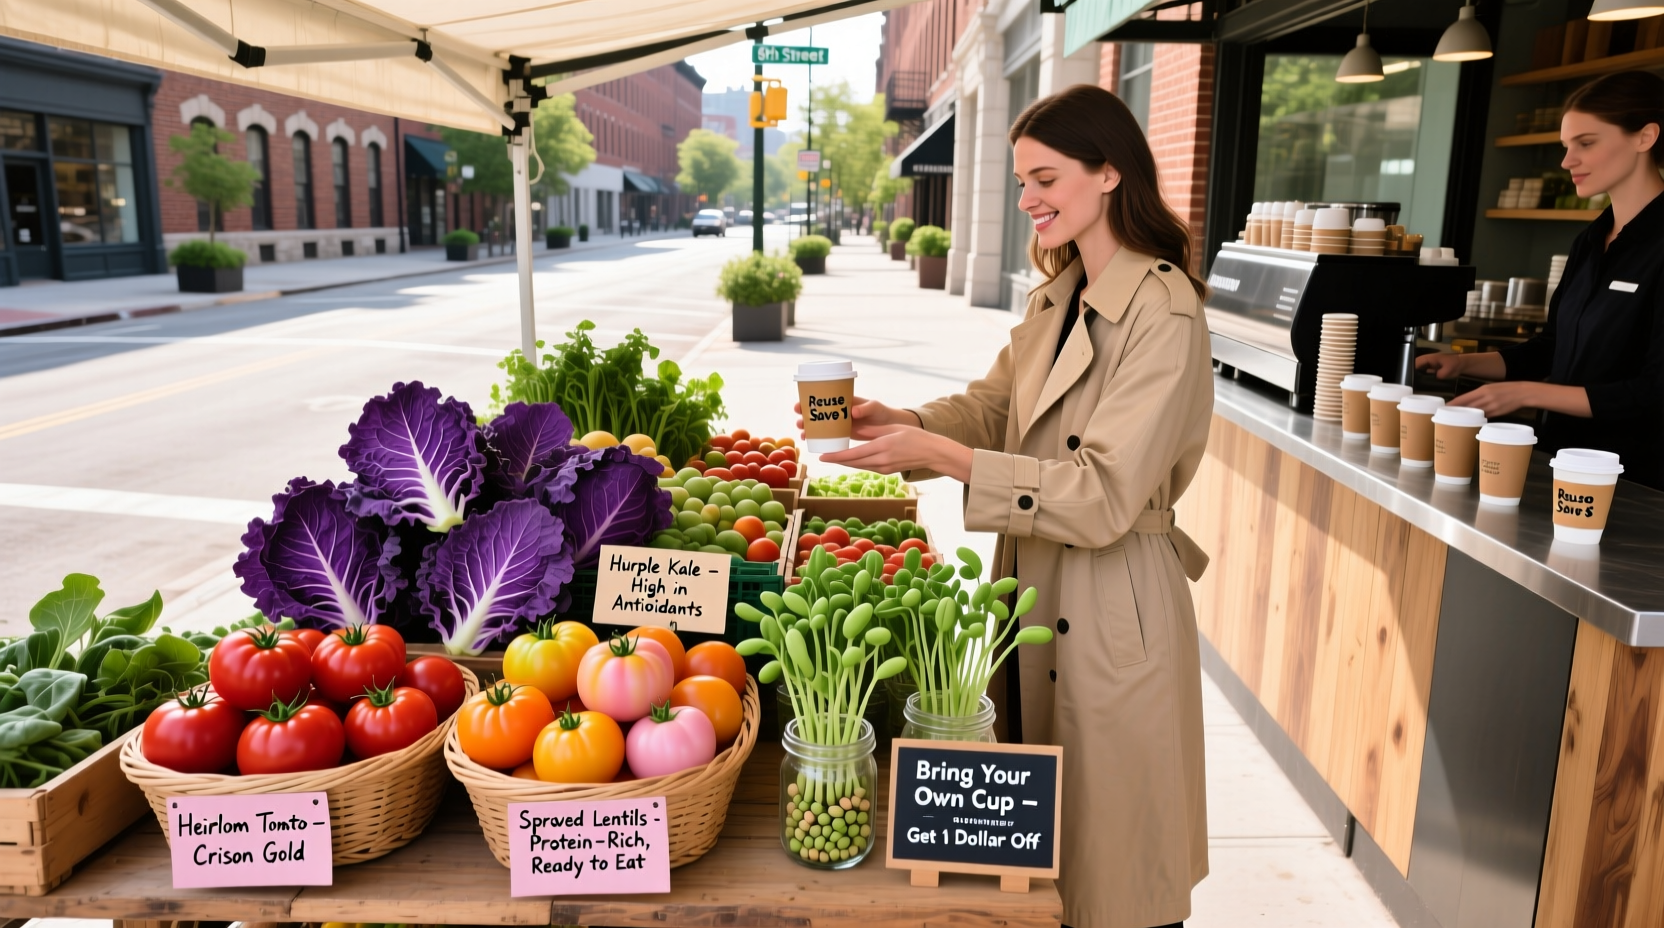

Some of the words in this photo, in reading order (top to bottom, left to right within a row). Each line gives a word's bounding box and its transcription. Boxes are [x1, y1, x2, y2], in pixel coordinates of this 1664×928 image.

[609, 554, 660, 577] Hurple
[668, 557, 701, 577] Kale
[631, 577, 666, 598] High
[673, 582, 687, 595] in
[611, 594, 703, 617] Antioidants
[916, 760, 974, 789] Bring
[981, 764, 1031, 786] Your
[914, 786, 964, 808] Own
[971, 789, 1015, 816] Cup
[178, 812, 249, 837] Heirlom
[255, 811, 308, 833] Tomto
[593, 808, 647, 827] Lentils
[907, 827, 937, 844] Get
[942, 828, 949, 845] 1
[955, 829, 1006, 848] Dollar
[1011, 832, 1042, 850] Off
[193, 843, 253, 866] Crison
[262, 839, 305, 864] Gold
[531, 855, 584, 879] Ready
[589, 854, 608, 871] to
[615, 853, 646, 870] Eat
